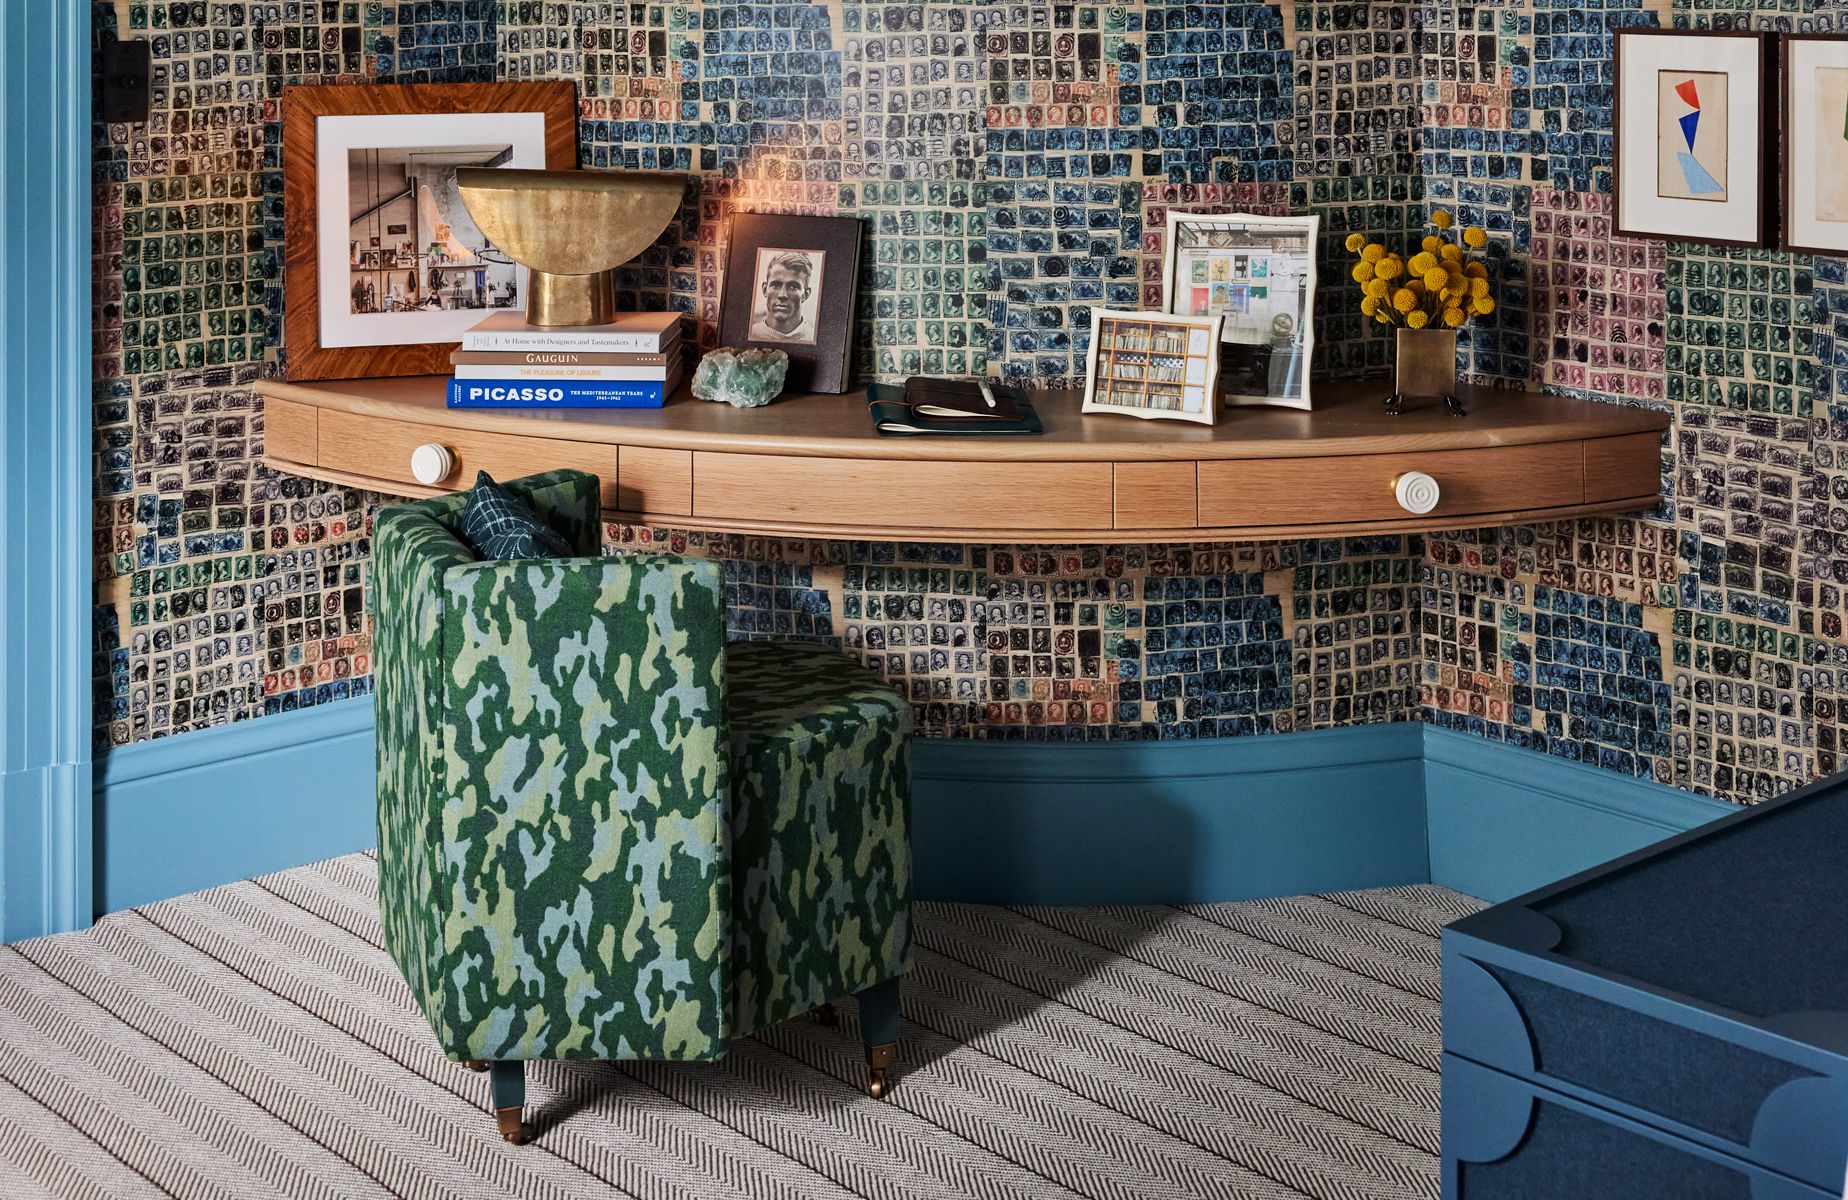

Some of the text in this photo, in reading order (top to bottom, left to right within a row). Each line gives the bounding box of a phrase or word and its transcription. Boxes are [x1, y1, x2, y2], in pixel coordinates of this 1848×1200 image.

[547, 338, 576, 347] Designers
[591, 338, 630, 346] Tastemakers
[526, 353, 579, 363] GAUGUIN
[469, 387, 564, 401] PICASSO
